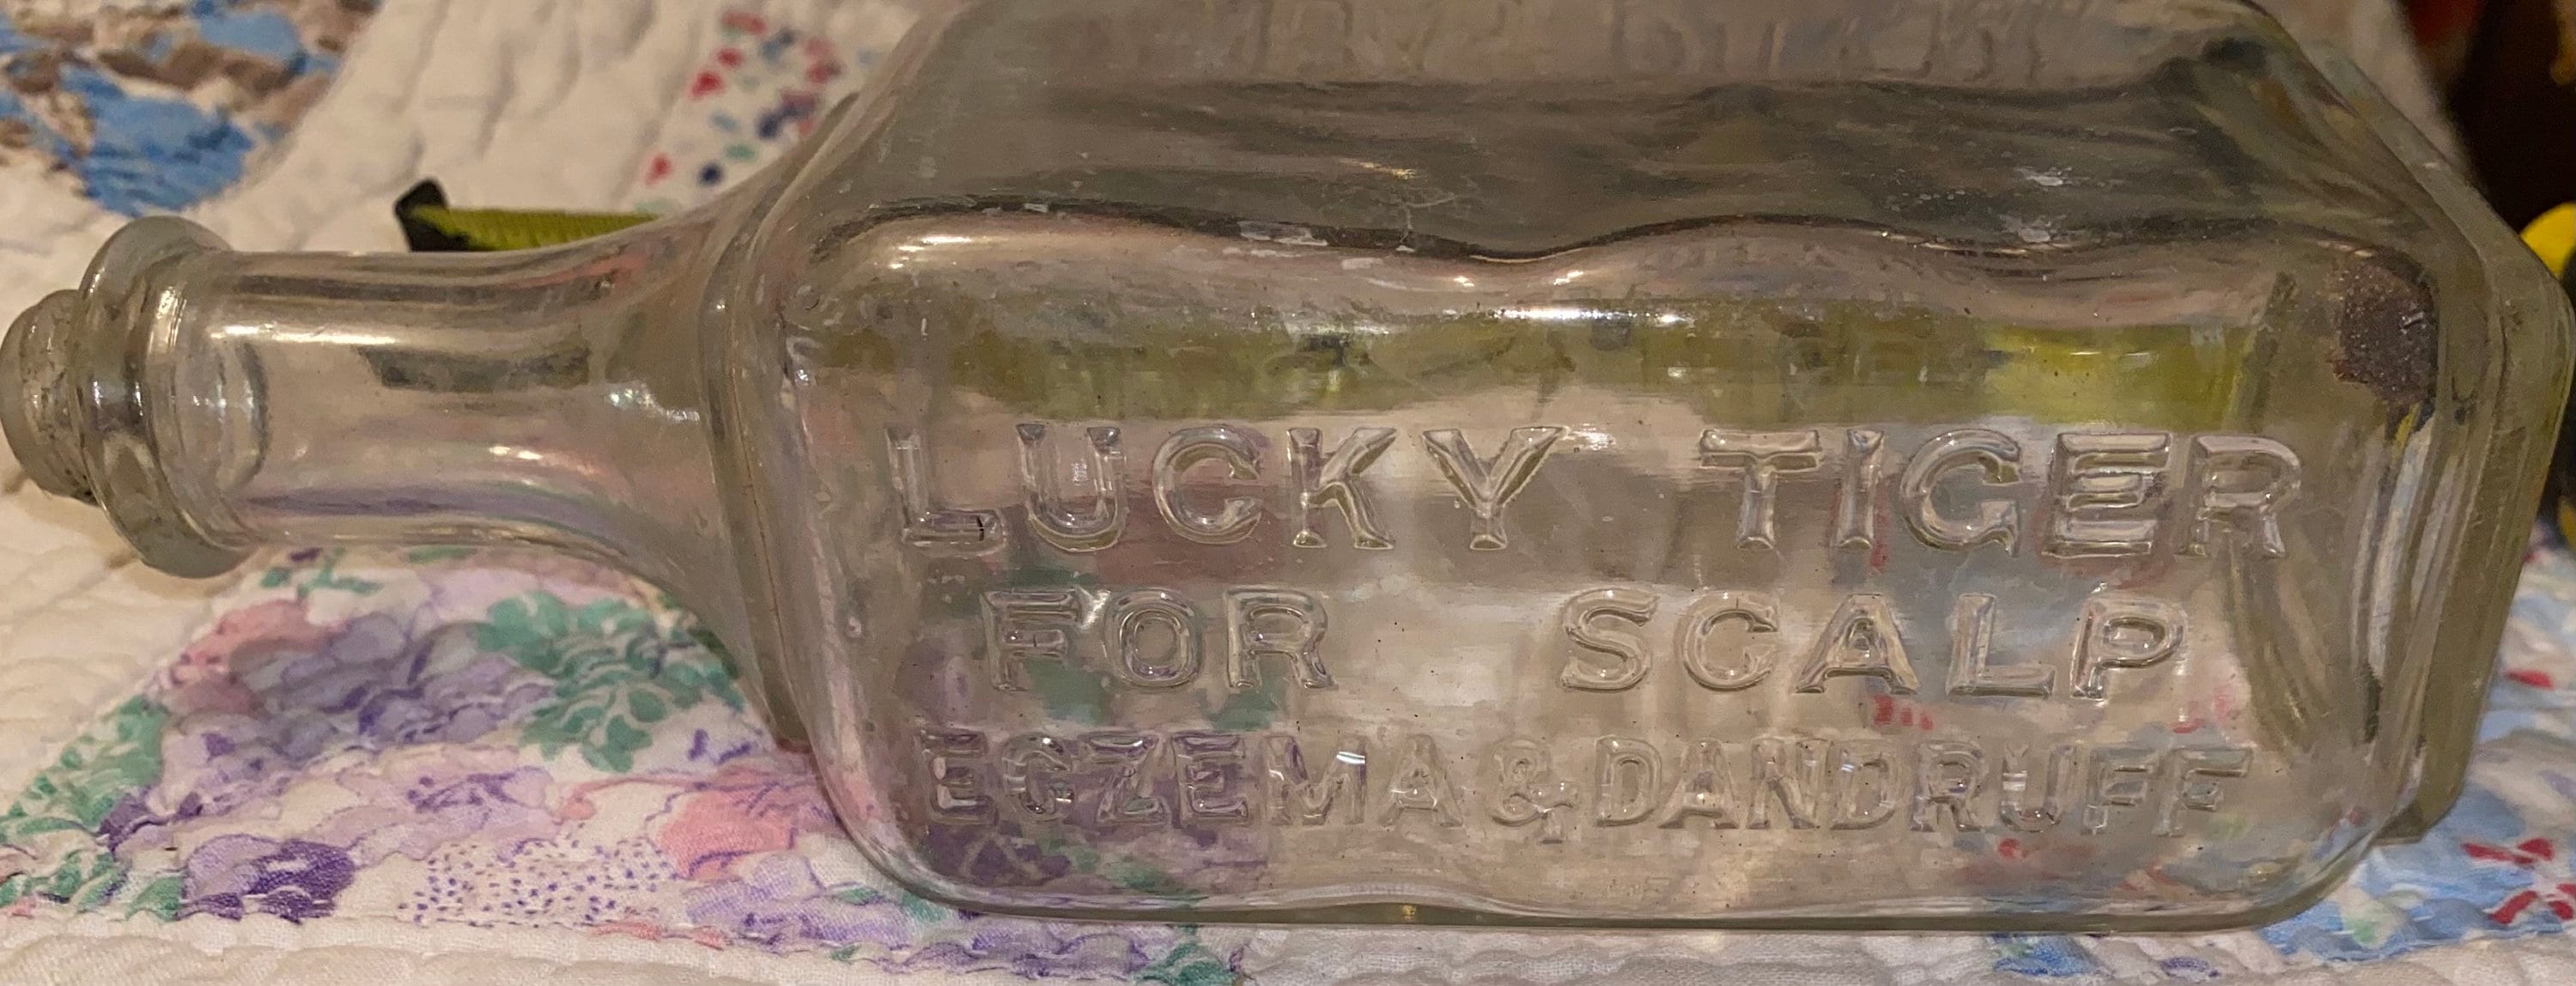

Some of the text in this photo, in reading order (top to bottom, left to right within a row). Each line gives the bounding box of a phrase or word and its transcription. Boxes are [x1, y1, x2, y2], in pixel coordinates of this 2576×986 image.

[886, 424, 2302, 557] LUCKY TIGER
[981, 587, 2187, 700] FOR SCALP
[920, 730, 2256, 843] ECZEMA & DANDRUFF
